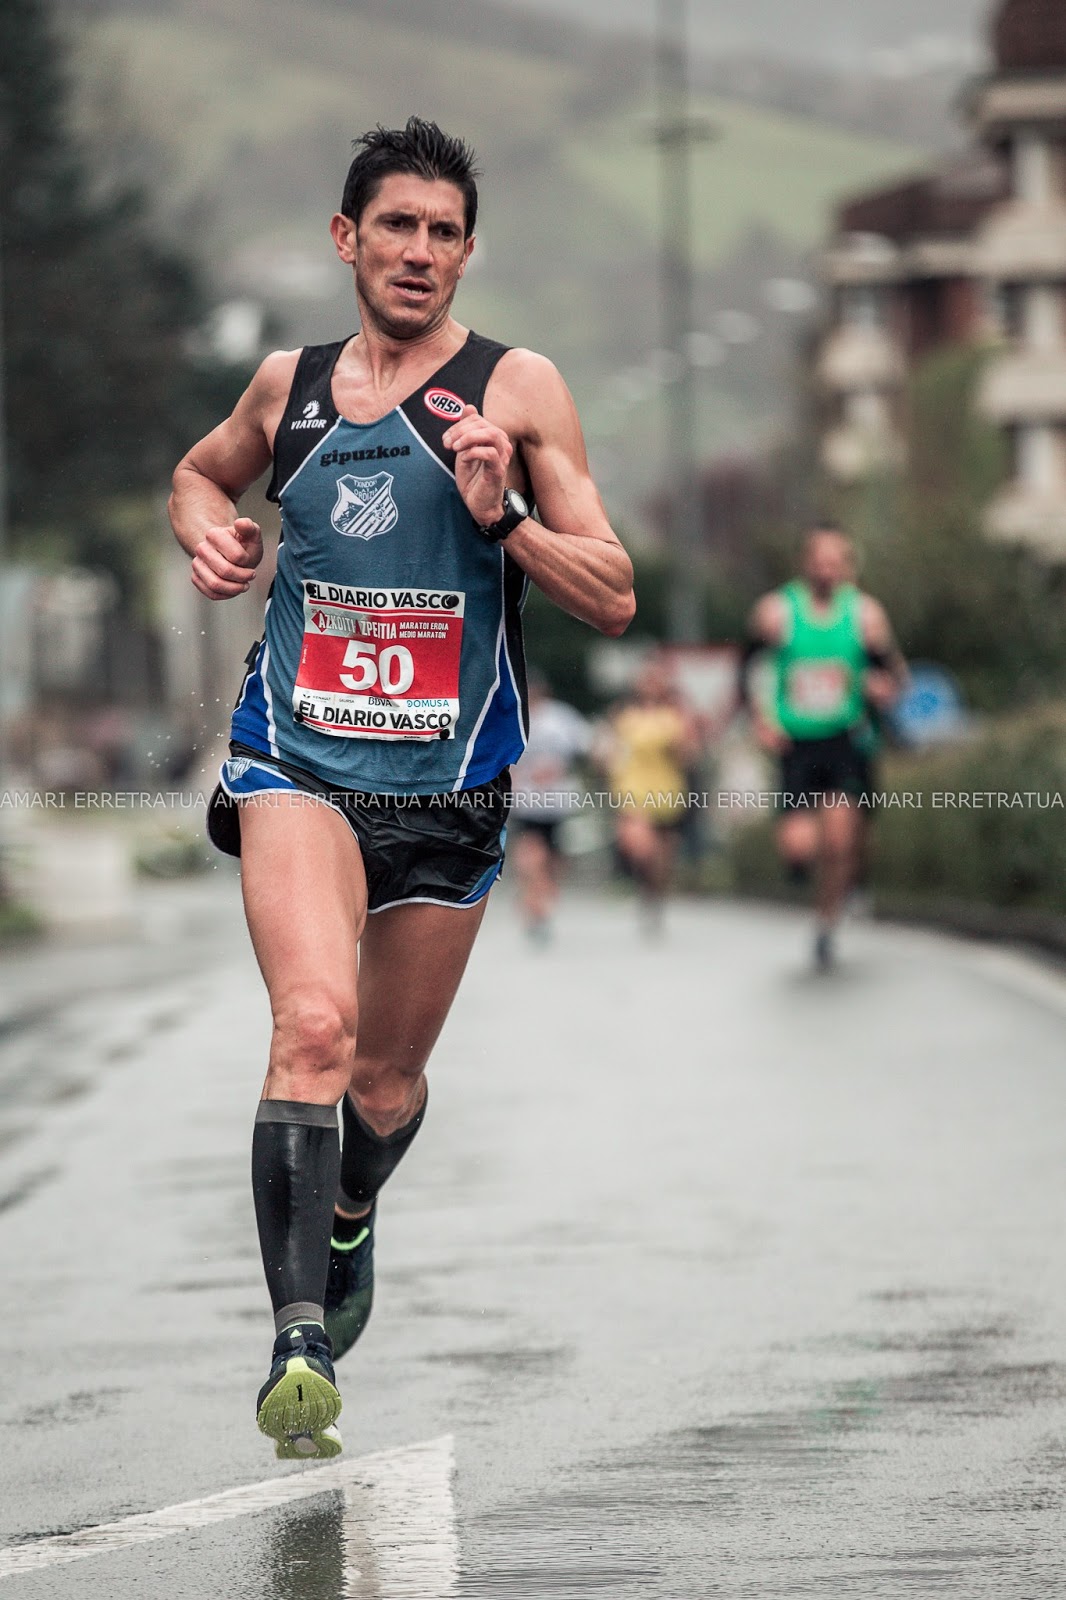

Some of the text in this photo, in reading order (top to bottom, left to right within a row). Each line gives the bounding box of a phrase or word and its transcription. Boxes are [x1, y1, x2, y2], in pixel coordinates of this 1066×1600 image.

[291, 419, 327, 430] VIATOR
[320, 444, 411, 467] gipuzkoa
[328, 586, 387, 608] DIARIO
[339, 640, 415, 695] 50
[368, 697, 393, 707] BBVA
[406, 699, 449, 708] DOMUSA
[299, 700, 320, 720] EL
[322, 706, 387, 728] DIARIO
[389, 712, 452, 730] VASCO
